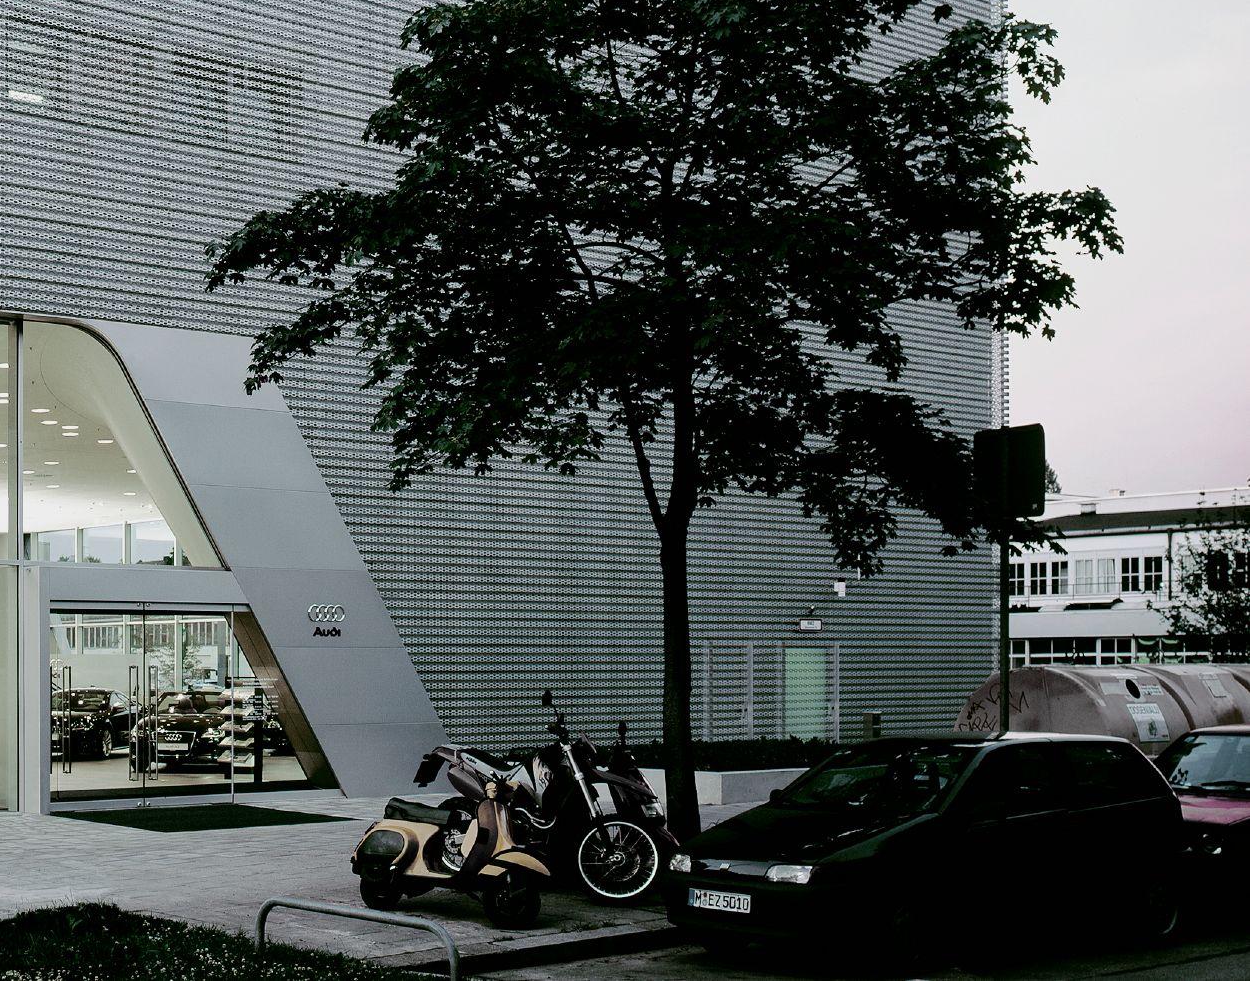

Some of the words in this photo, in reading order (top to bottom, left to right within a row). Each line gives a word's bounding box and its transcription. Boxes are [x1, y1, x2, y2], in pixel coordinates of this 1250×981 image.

[312, 626, 342, 637] Audi
[695, 891, 701, 907] M
[708, 894, 721, 907] EZ
[723, 896, 749, 910] 5010
